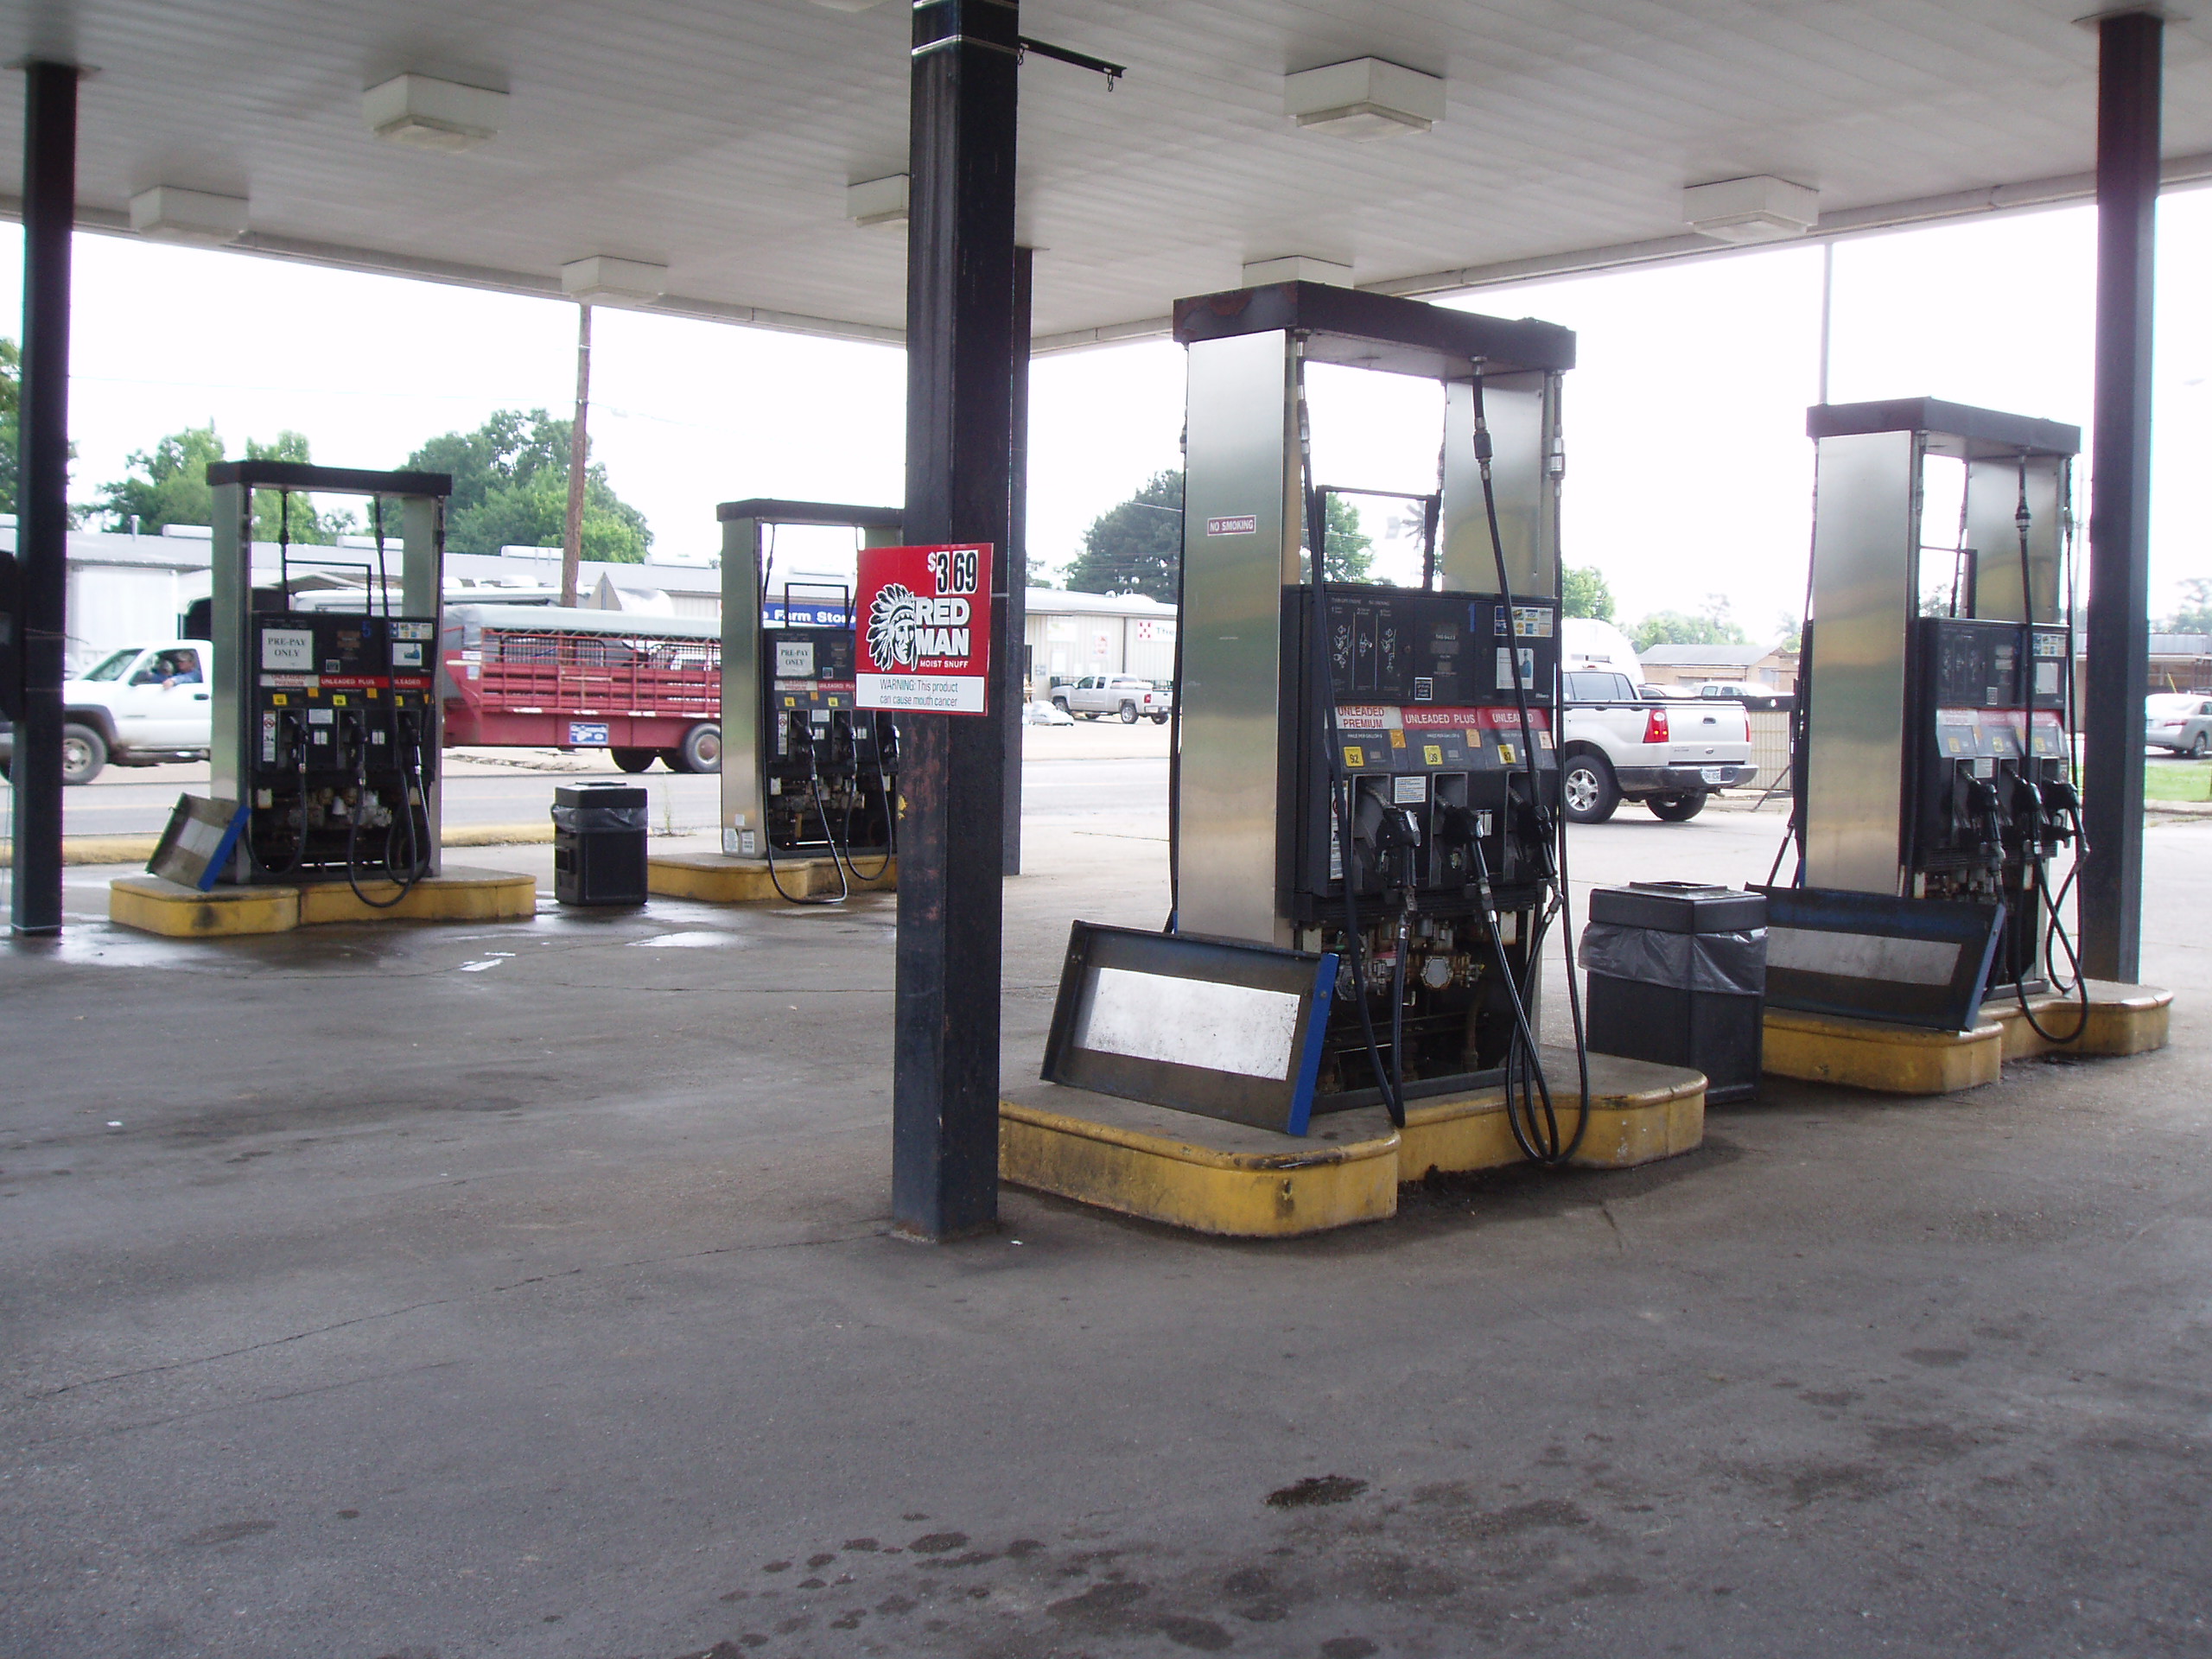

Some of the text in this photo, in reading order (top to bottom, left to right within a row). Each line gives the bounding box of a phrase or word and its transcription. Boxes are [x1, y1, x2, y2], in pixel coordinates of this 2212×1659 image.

[1210, 519, 1254, 531] NO SMOKING
[916, 597, 970, 626] RED
[268, 637, 306, 646] PRE-PAY
[916, 627, 970, 657] MAN
[919, 659, 969, 669] MOIST SNUFF
[918, 679, 931, 691] This
[932, 681, 958, 694] product
[880, 695, 957, 707] can cause mouth cancer
[1338, 706, 1385, 716] UNLEADED
[1343, 718, 1384, 728] PREMIUM
[1405, 714, 1476, 724] UNLEADED PLUS
